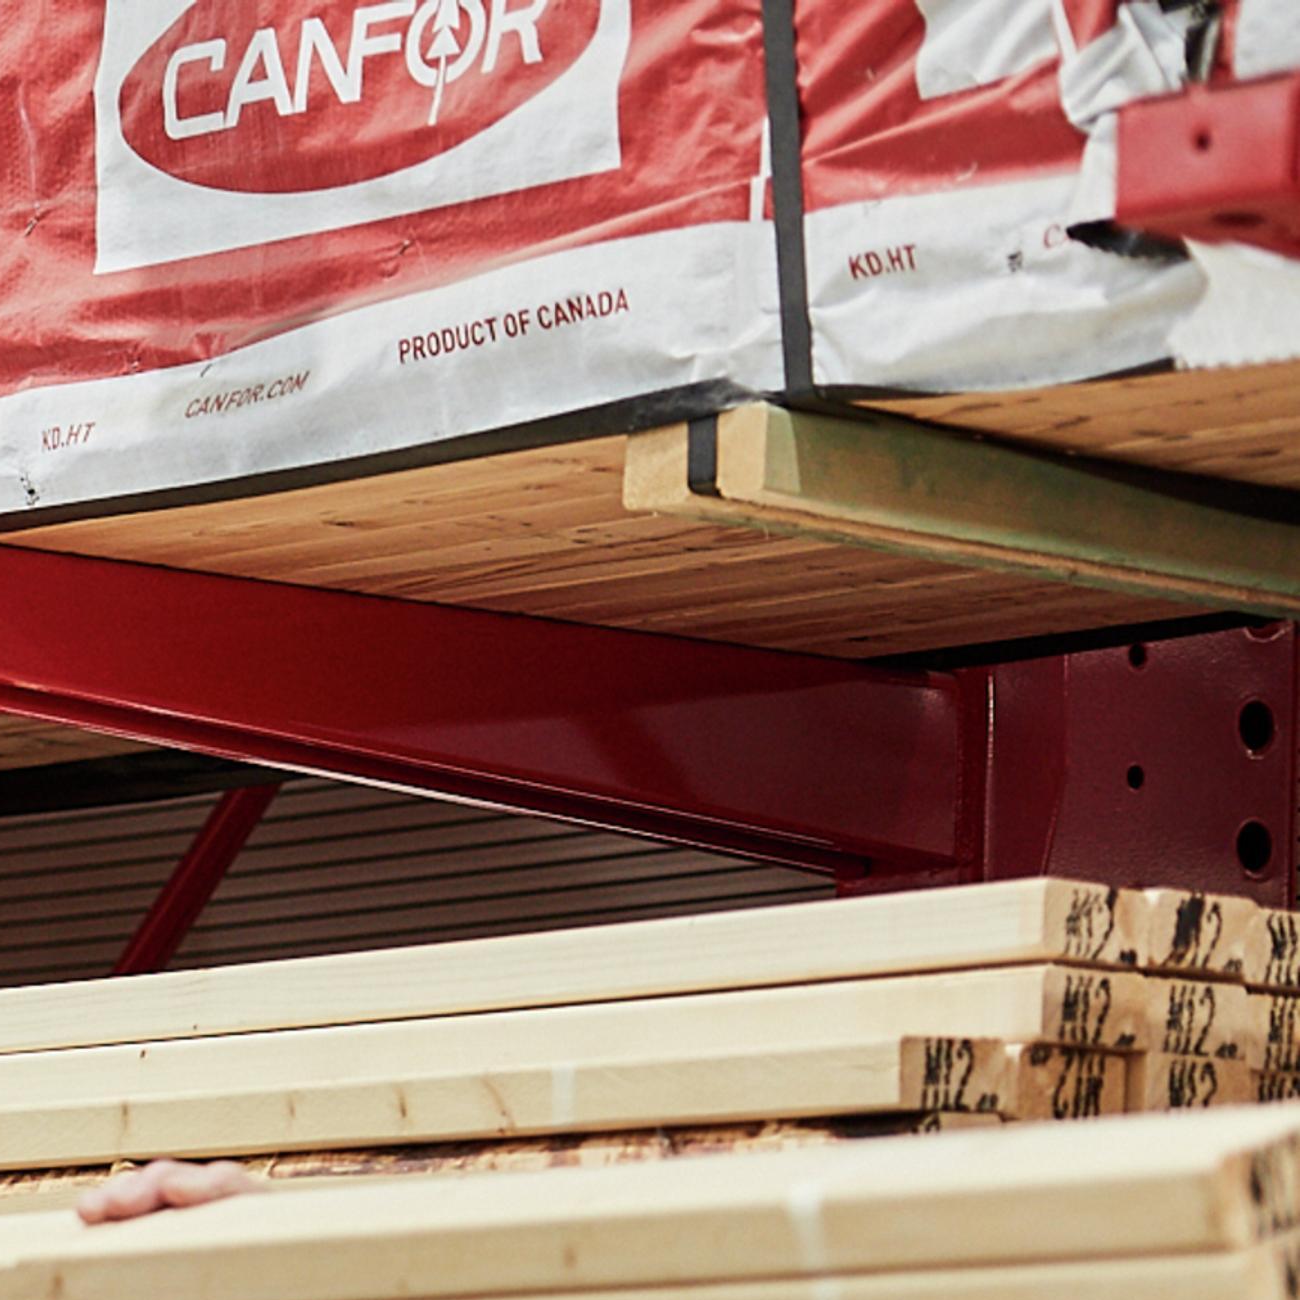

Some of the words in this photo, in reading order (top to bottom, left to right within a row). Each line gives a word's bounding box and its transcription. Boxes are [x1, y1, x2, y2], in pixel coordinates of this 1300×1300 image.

[162, 0, 543, 140] CANFOR
[847, 245, 918, 281] KD.HT
[397, 318, 499, 365] PRODUCT
[503, 309, 531, 339] OF
[536, 289, 630, 333] CANADA
[184, 369, 311, 420] CANFOR.COM
[41, 421, 95, 452] KD.HT
